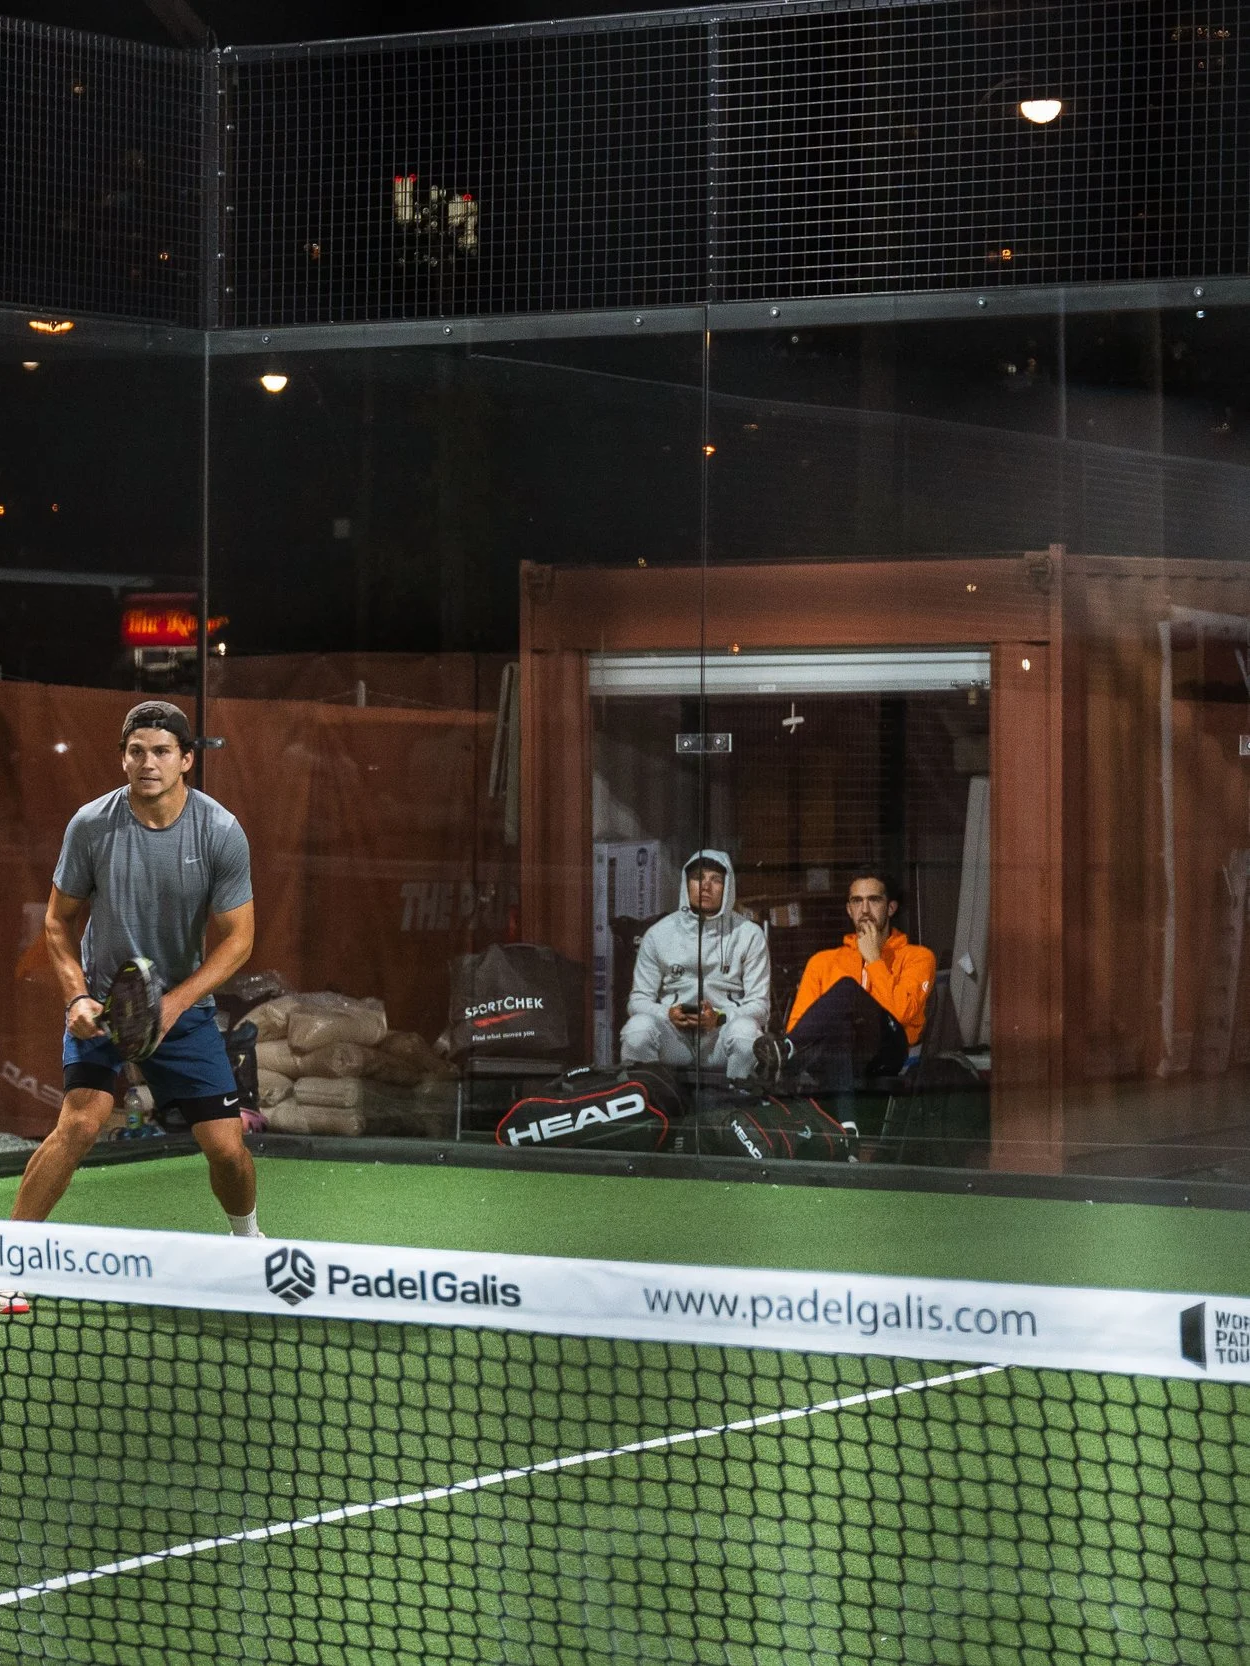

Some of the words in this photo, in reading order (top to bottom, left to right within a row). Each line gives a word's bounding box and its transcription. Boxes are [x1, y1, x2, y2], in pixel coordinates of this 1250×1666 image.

[567, 1066, 590, 1077] HEAD
[507, 1093, 646, 1147] HEAD
[731, 1119, 762, 1160] HEAD
[643, 1287, 1038, 1337] www.padelgalis.com
[1215, 1310, 1250, 1330] WOR
[1216, 1330, 1250, 1348] PAD
[1215, 1347, 1250, 1364] TOU
